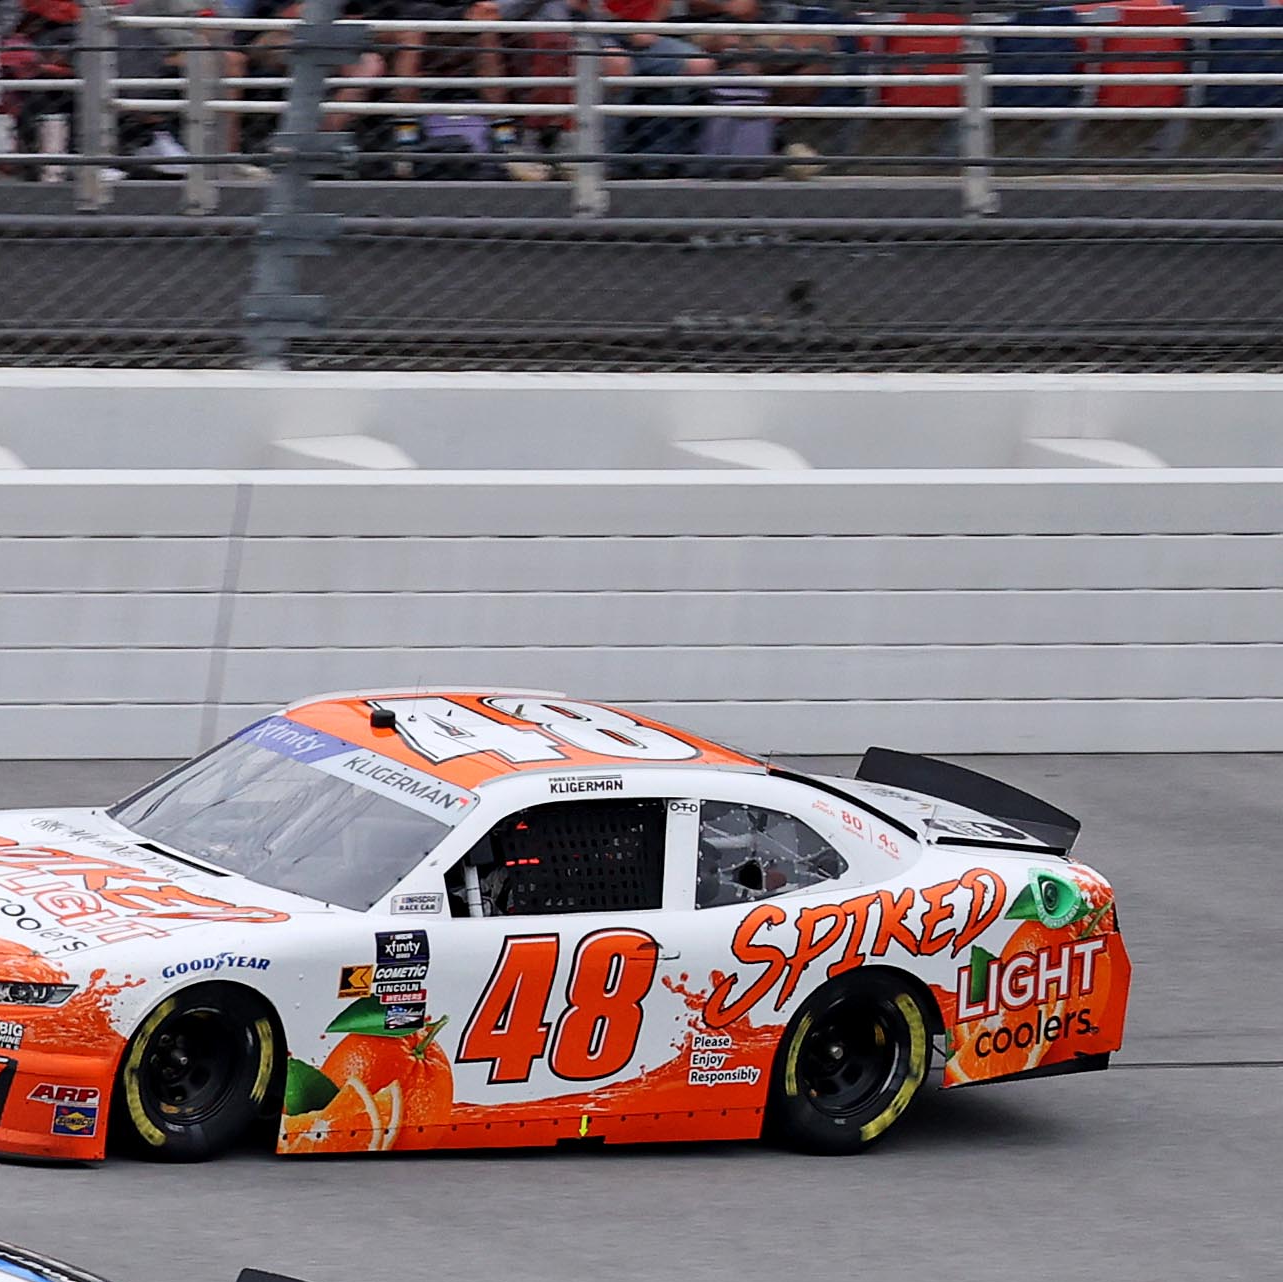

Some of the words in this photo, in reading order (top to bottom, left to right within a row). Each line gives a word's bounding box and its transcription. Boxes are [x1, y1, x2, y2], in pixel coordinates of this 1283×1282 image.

[366, 696, 701, 763] 48
[253, 722, 325, 756] xfinity
[343, 755, 459, 809] KLIGERMAN
[550, 780, 623, 794] KLIGERMAN
[399, 903, 418, 911] RACE
[385, 941, 420, 956] xfinity
[702, 867, 1007, 1029] SPIKED
[162, 952, 271, 980] GOODYEAR
[376, 964, 427, 979] COMETIC
[957, 935, 1107, 1023] LIGHT
[377, 983, 419, 993] LINCOLN
[457, 929, 658, 1083] 48
[0, 1021, 23, 1037] BIG
[975, 1008, 1091, 1057] coolers
[694, 1036, 730, 1047] Please
[692, 1054, 724, 1067] Enjoy
[690, 1069, 758, 1084] Responsibly
[32, 1085, 99, 1103] ARP
